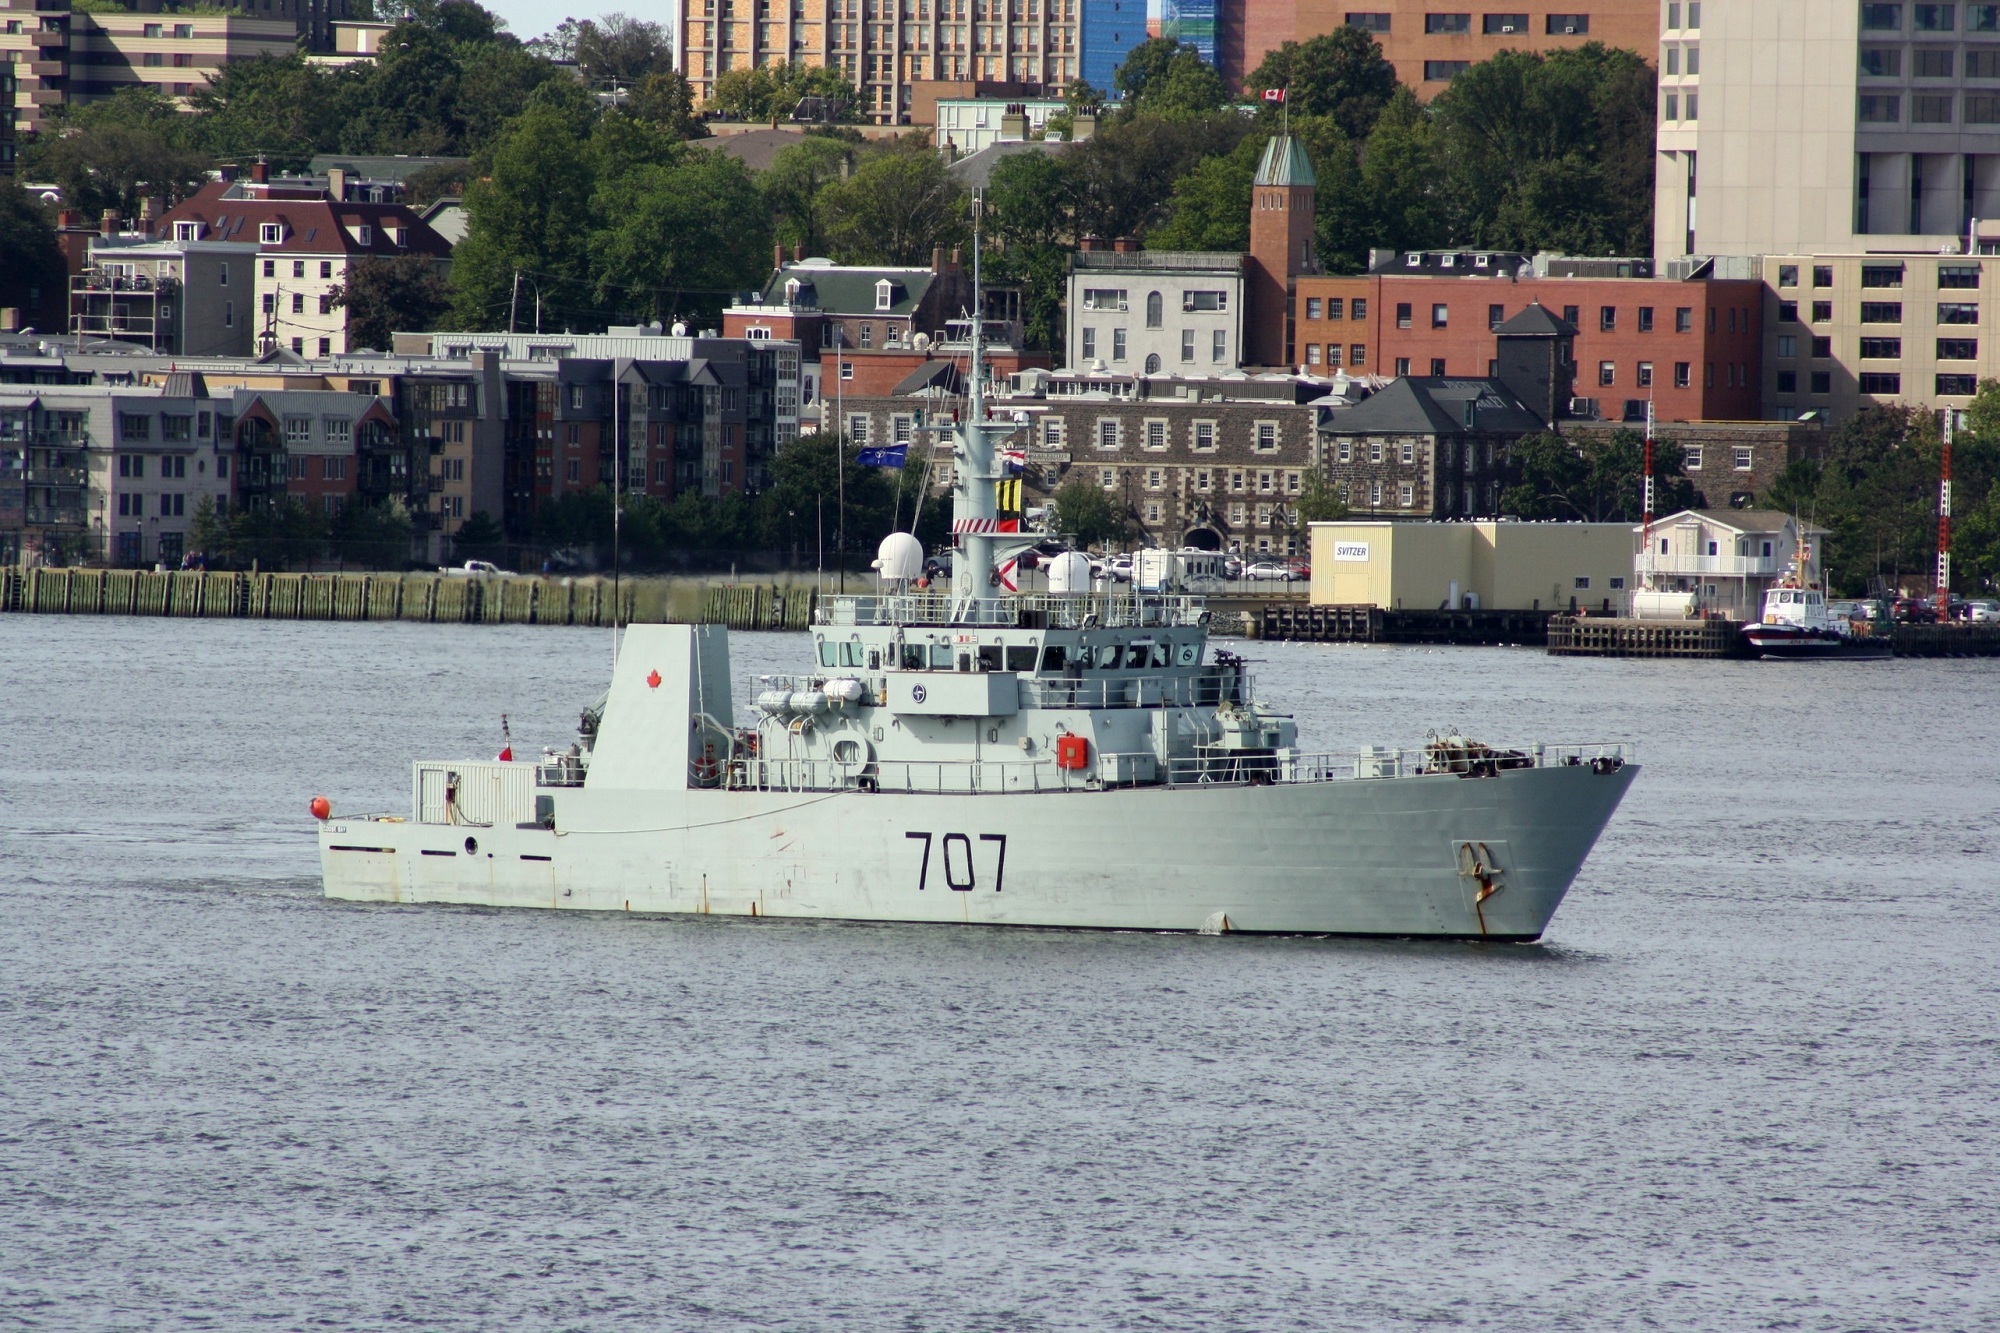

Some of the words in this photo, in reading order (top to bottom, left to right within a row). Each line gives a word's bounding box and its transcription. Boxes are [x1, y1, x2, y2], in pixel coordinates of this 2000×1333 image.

[1337, 546, 1367, 556] SVITZER
[1805, 605, 1824, 617] PILOT
[905, 831, 1007, 892] 707
